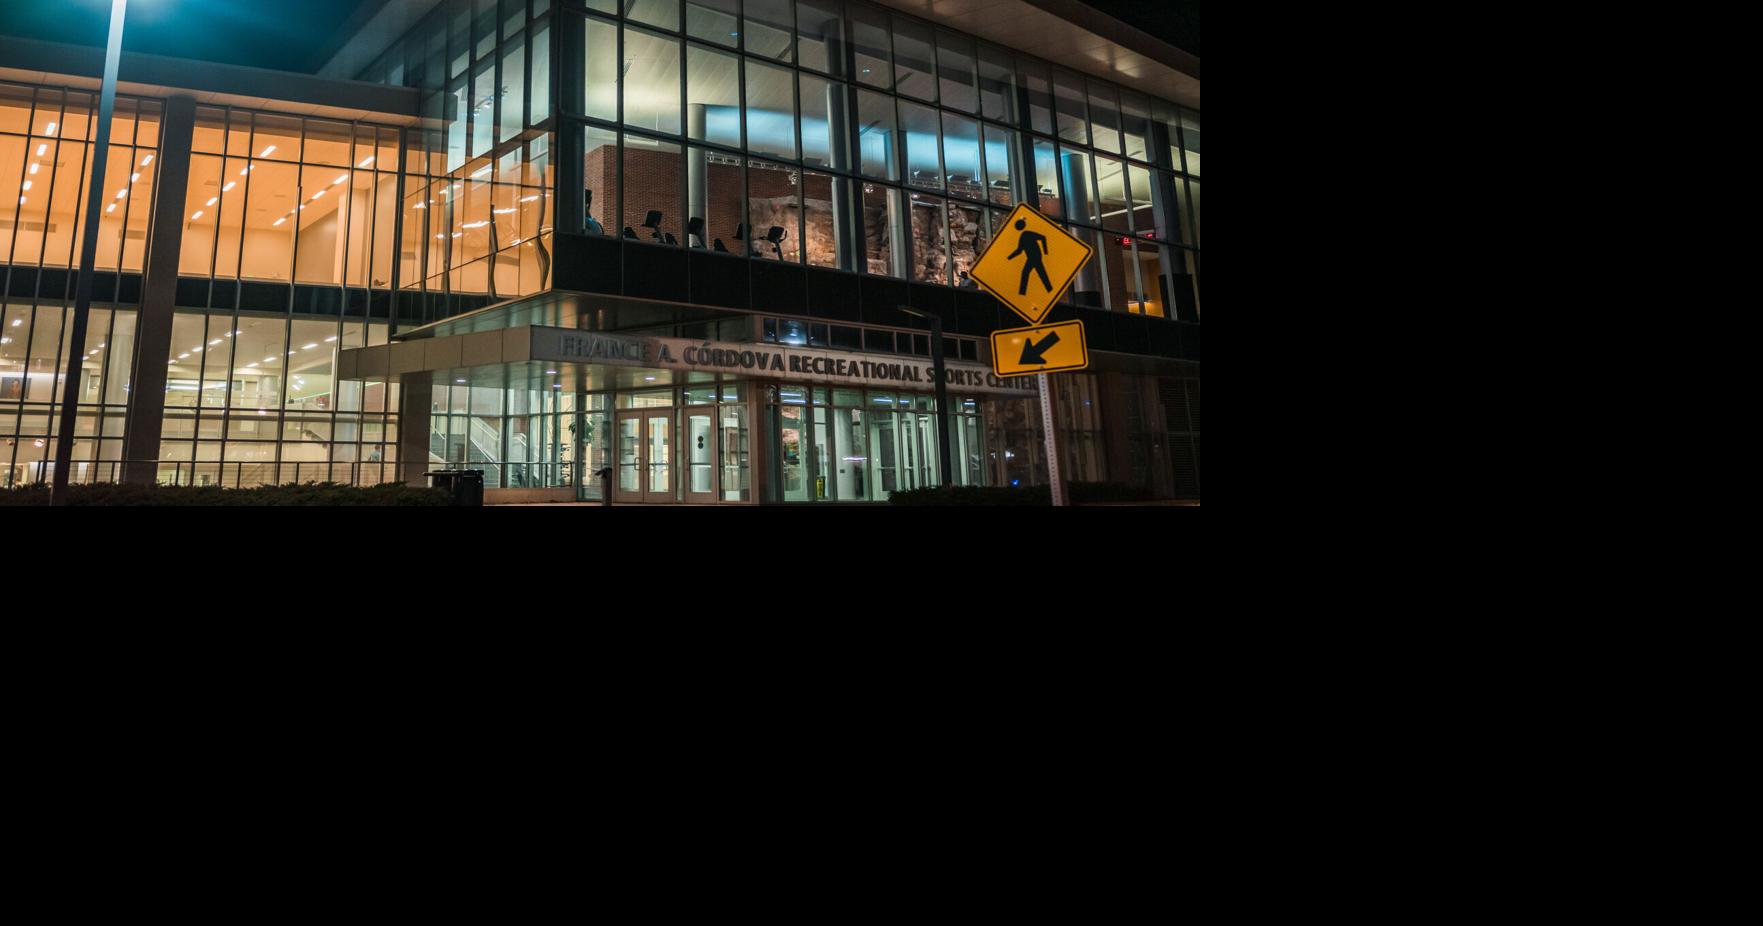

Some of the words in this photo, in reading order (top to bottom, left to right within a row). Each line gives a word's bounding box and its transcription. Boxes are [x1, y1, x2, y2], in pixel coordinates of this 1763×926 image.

[657, 343, 678, 363] A.
[683, 342, 785, 372] CÓRDOVA
[789, 353, 923, 383] RECREATIONAL
[925, 367, 984, 387] SORTS
